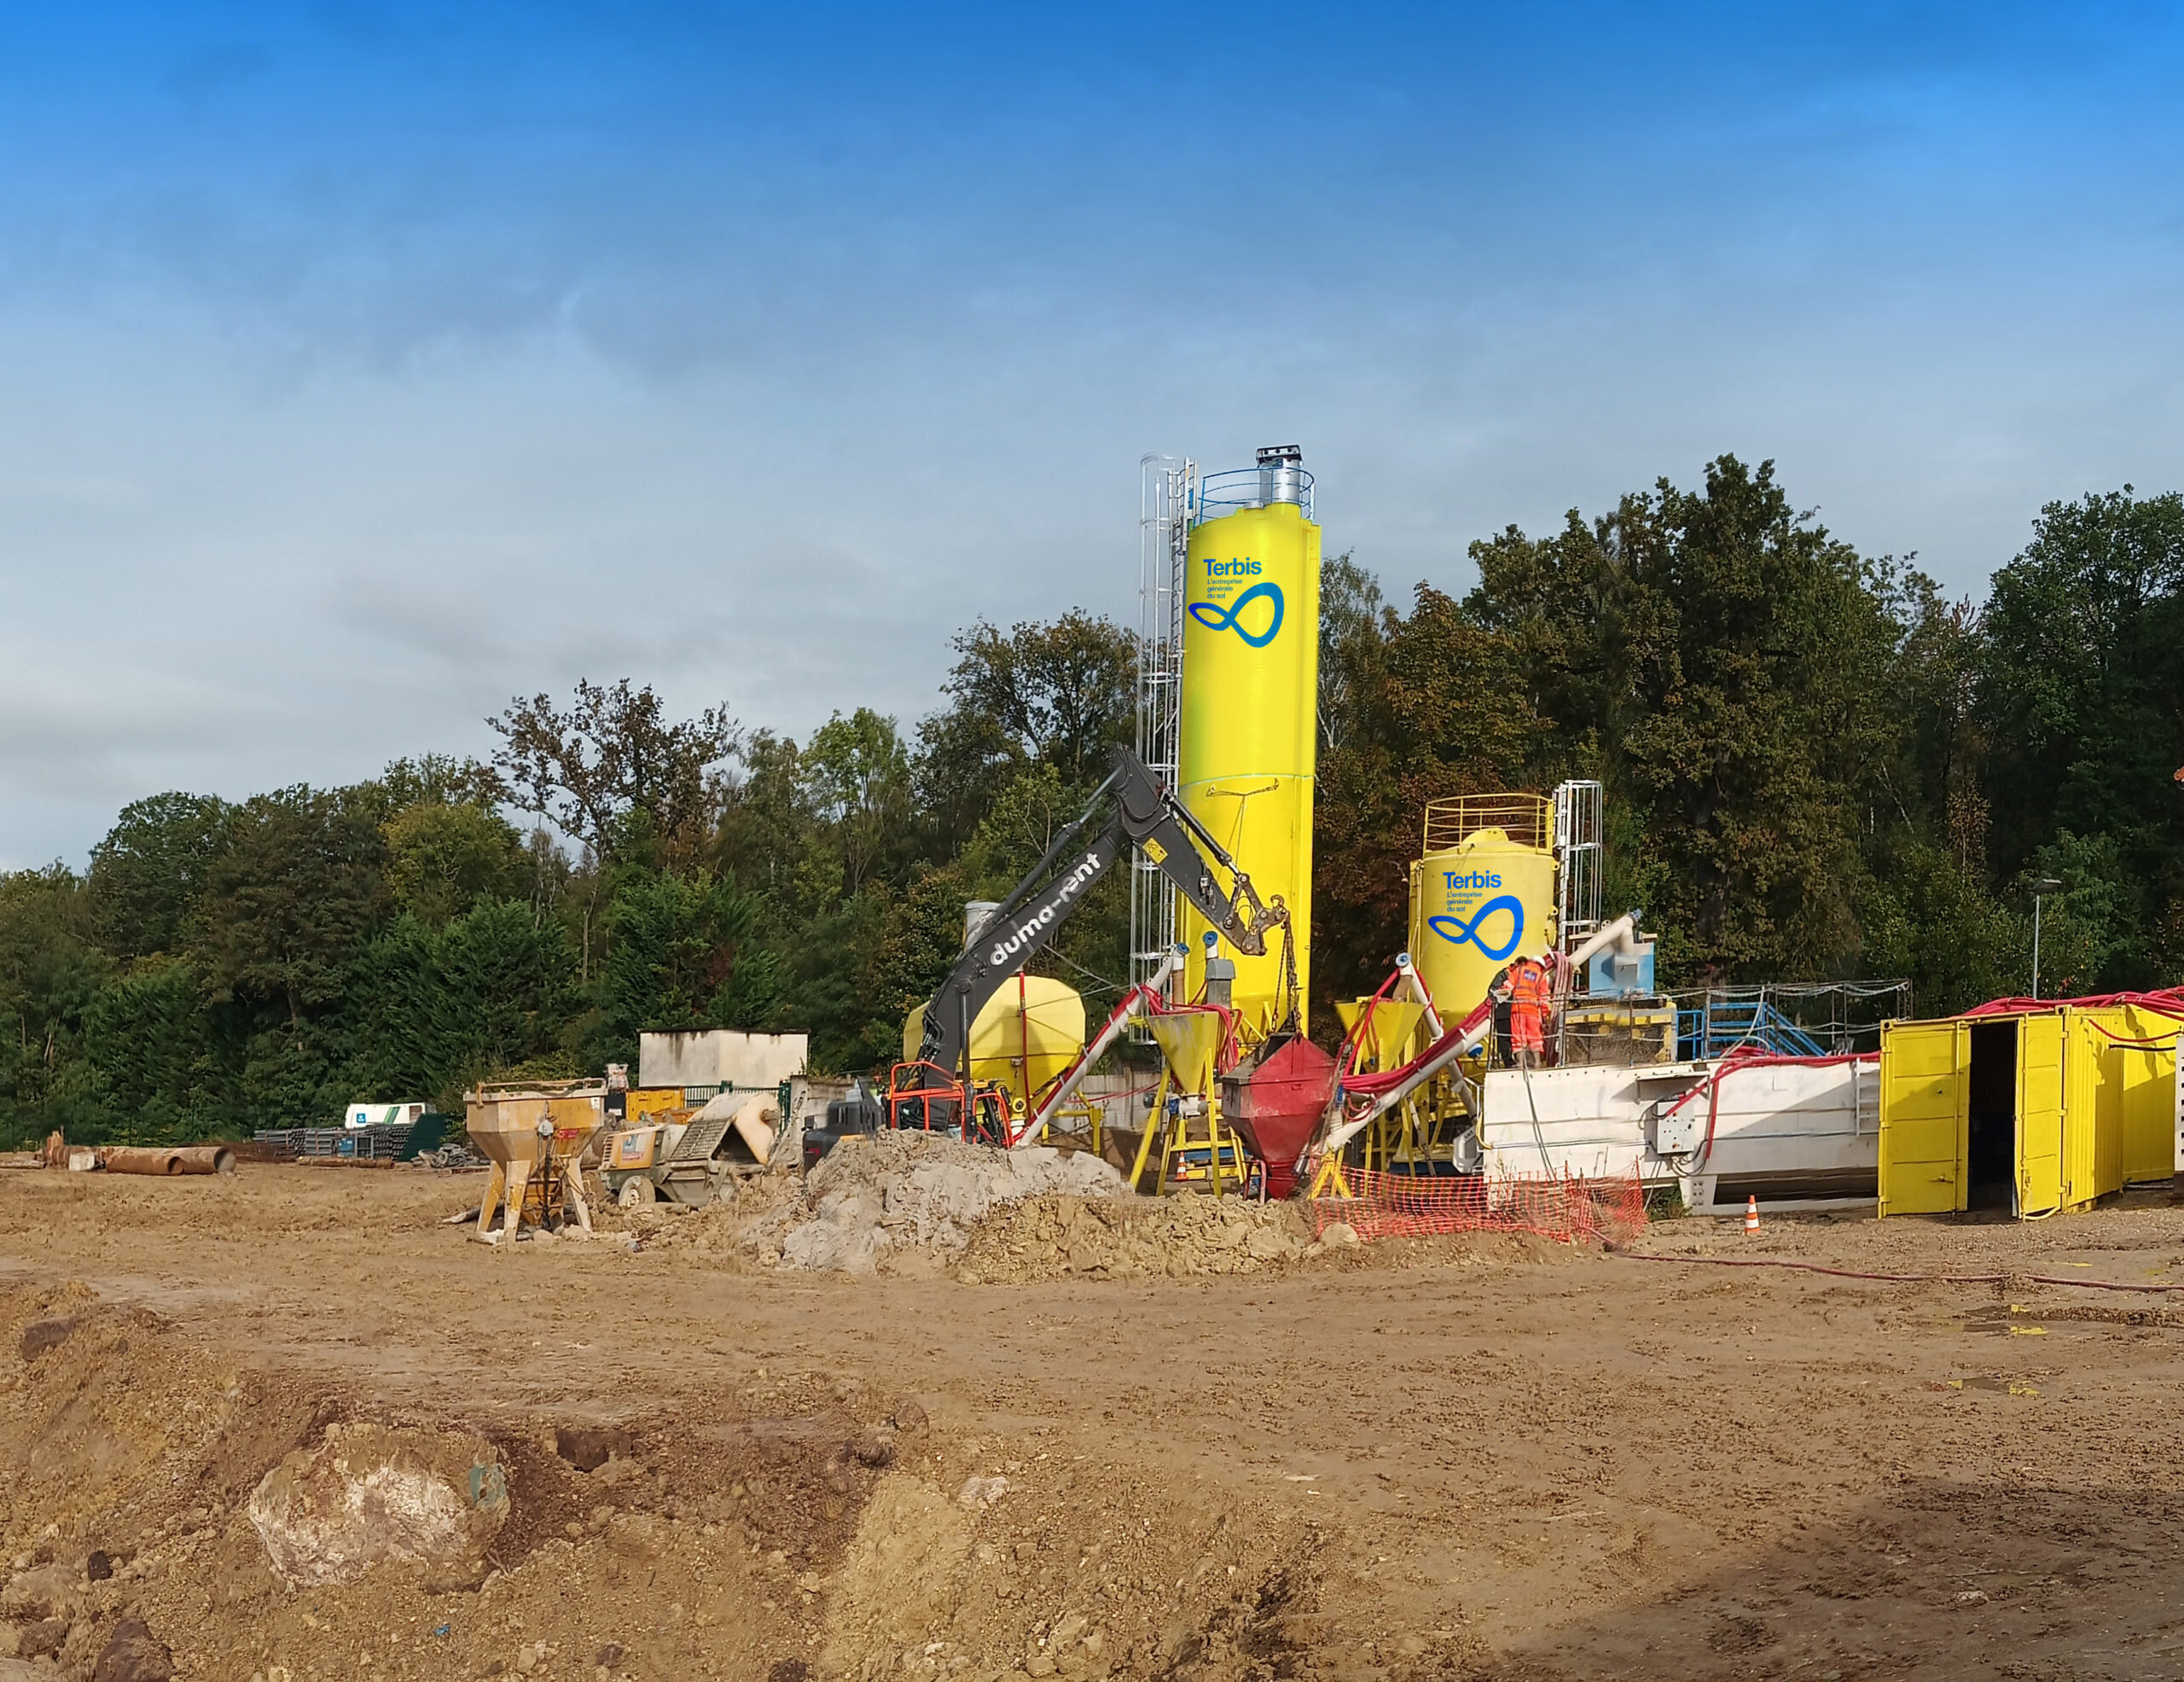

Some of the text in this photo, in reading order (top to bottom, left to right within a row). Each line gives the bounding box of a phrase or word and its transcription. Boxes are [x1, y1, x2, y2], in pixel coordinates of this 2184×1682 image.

[1203, 557, 1262, 576] Terbis
[1443, 870, 1502, 889] Terbis
[990, 853, 1101, 965] duma-rent
